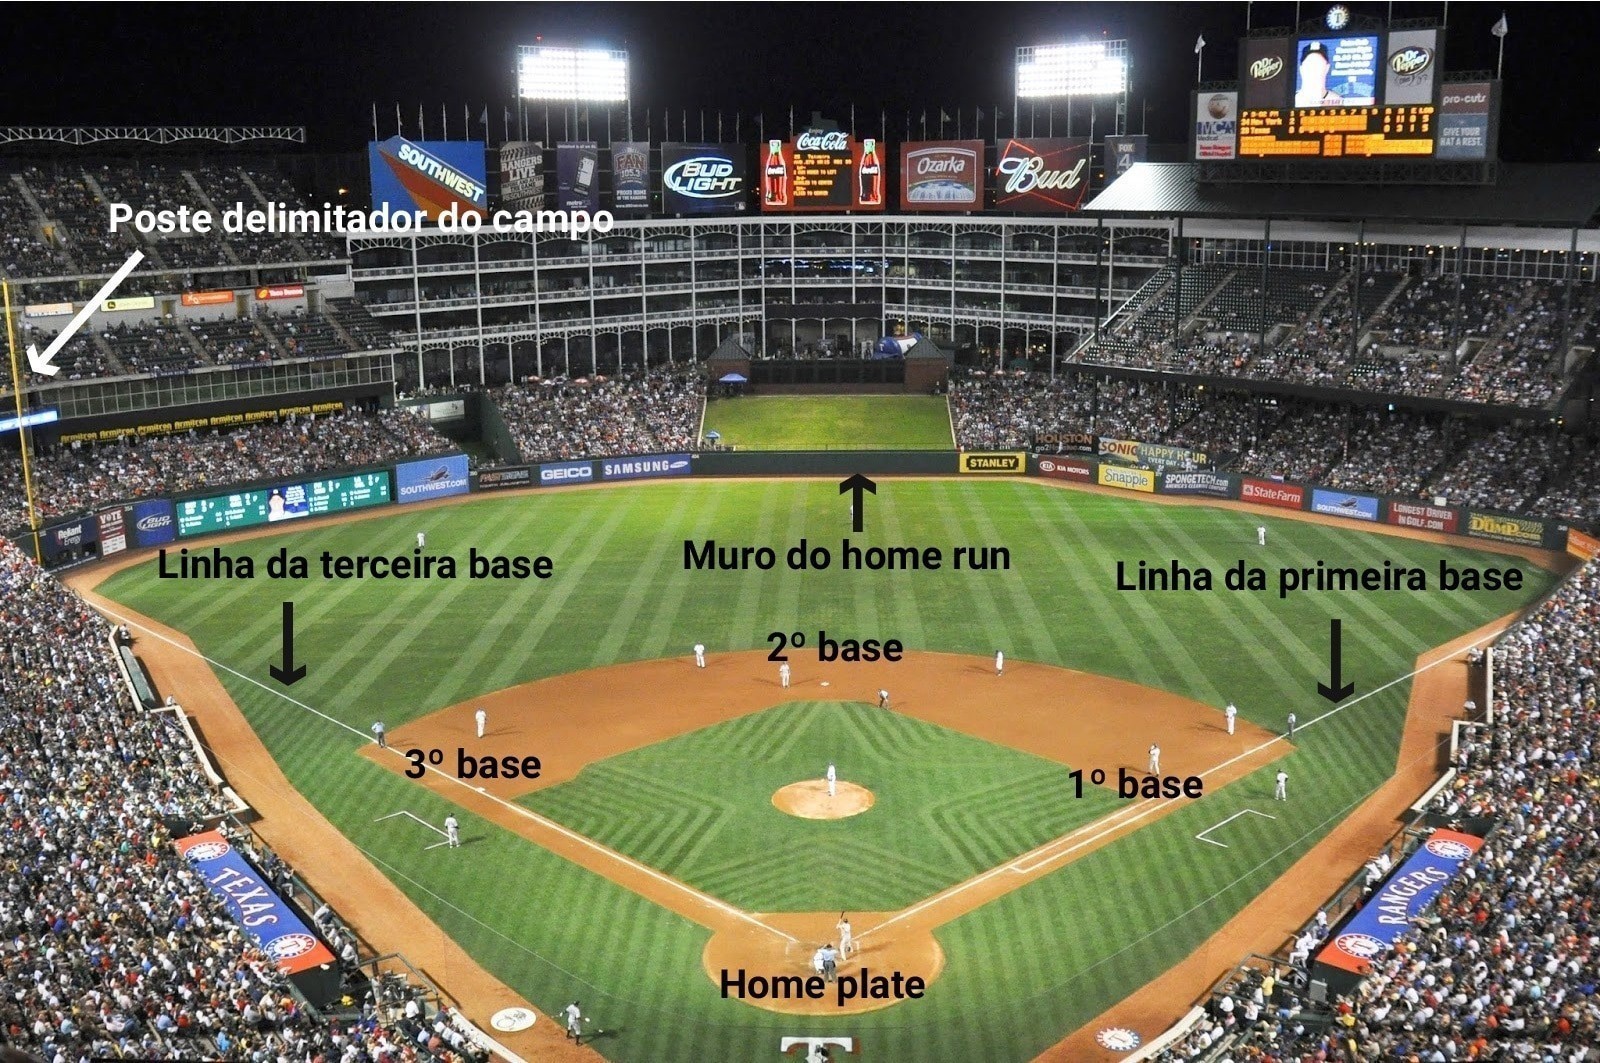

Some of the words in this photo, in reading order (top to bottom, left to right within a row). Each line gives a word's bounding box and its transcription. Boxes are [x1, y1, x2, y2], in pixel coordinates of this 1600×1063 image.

[1262, 57, 1273, 67] Dr
[1405, 50, 1418, 60] Dr
[1253, 60, 1279, 78] Pepper
[1395, 54, 1427, 73] Pepper
[1442, 127, 1460, 136] GIVE
[1461, 127, 1480, 136] YOUR
[796, 131, 849, 150] Coca-Cola
[1118, 144, 1134, 152] FOX
[1440, 138, 1455, 147] HAT
[501, 155, 543, 172] RANGERS
[616, 154, 646, 171] FAN
[917, 156, 965, 175] Ozarka
[1119, 153, 1131, 169] 4
[398, 143, 485, 203] SOUTHWEST
[509, 165, 536, 181] LIVE
[621, 169, 641, 178] 105.3
[682, 162, 733, 177] BUD
[999, 156, 1087, 194] Bud
[672, 177, 742, 191] LIGHT
[1035, 433, 1092, 444] HOUSTON
[1101, 442, 1138, 456] SONIC
[1141, 446, 1174, 458] HAPPY
[1177, 451, 1207, 464] HUR
[604, 460, 669, 475] SAMSUNG
[970, 458, 1015, 468] STANLEY
[1067, 466, 1089, 475] MOTORS
[541, 466, 592, 480] GEICO
[1104, 468, 1148, 488] Snapple
[1165, 473, 1229, 487] SPONGETECH.com
[400, 479, 467, 495] SOUTHWEST.COM
[1254, 486, 1277, 500] State
[1277, 490, 1301, 503] Farm
[99, 510, 122, 525] VOTE
[1316, 503, 1373, 518] SOUTHWEST.COM
[1393, 502, 1425, 515] LONGEST
[1426, 507, 1453, 520] DRIVER
[142, 519, 173, 530] LIGHT
[146, 515, 170, 524] BUD
[58, 524, 82, 540] Reliant
[64, 535, 82, 546] Energy
[210, 867, 278, 927] TEXAS
[1378, 866, 1449, 925] RANGERS
[780, 1036, 853, 1063] T
